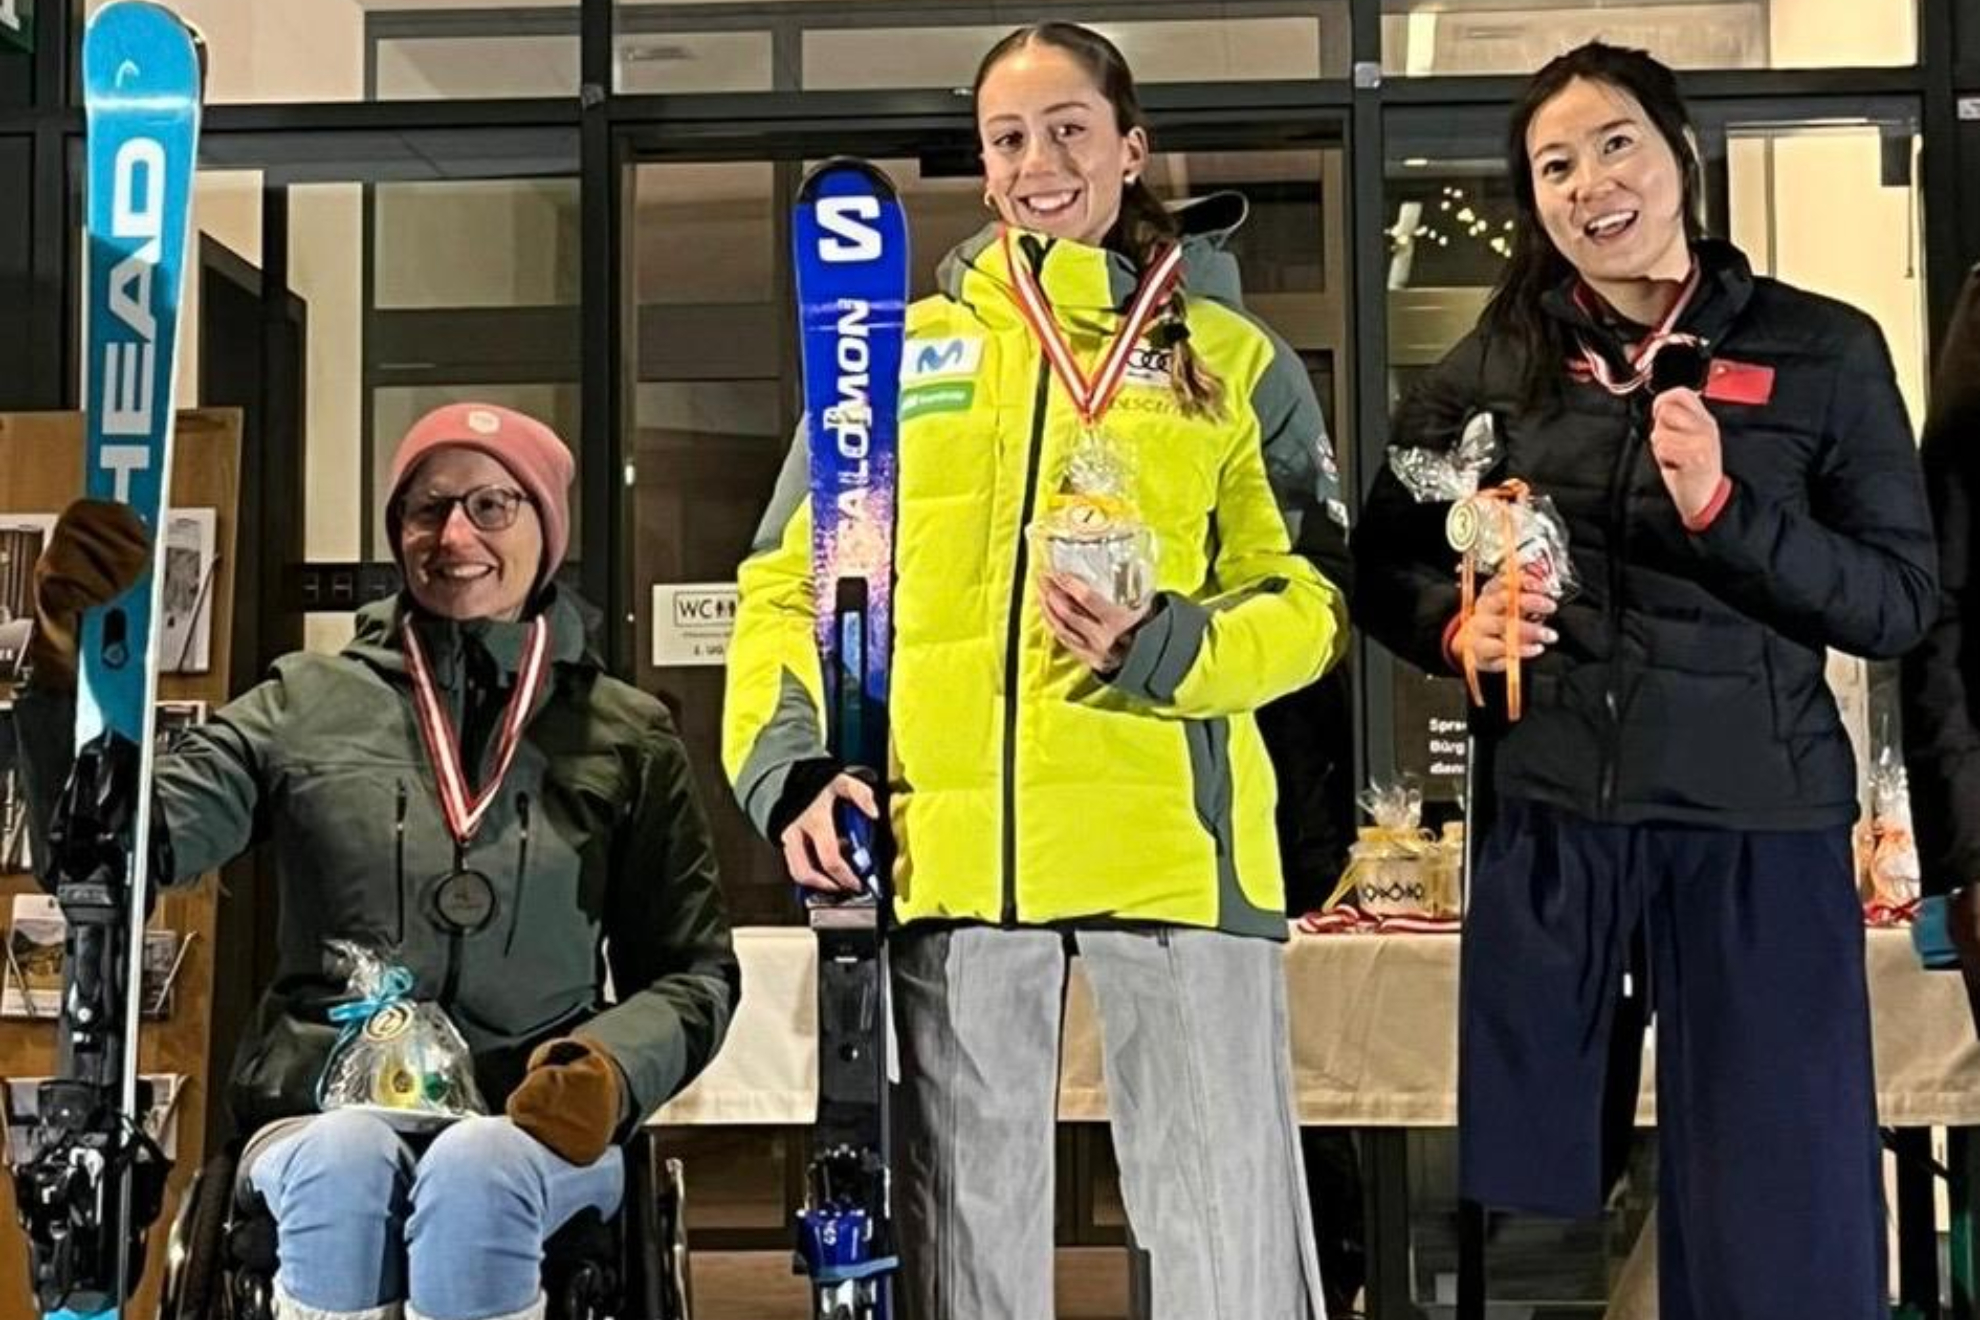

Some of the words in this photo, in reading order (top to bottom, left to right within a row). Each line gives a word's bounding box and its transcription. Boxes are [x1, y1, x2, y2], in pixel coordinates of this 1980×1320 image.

[816, 195, 882, 262] S
[99, 136, 166, 504] HEAD
[679, 600, 713, 618] WC
